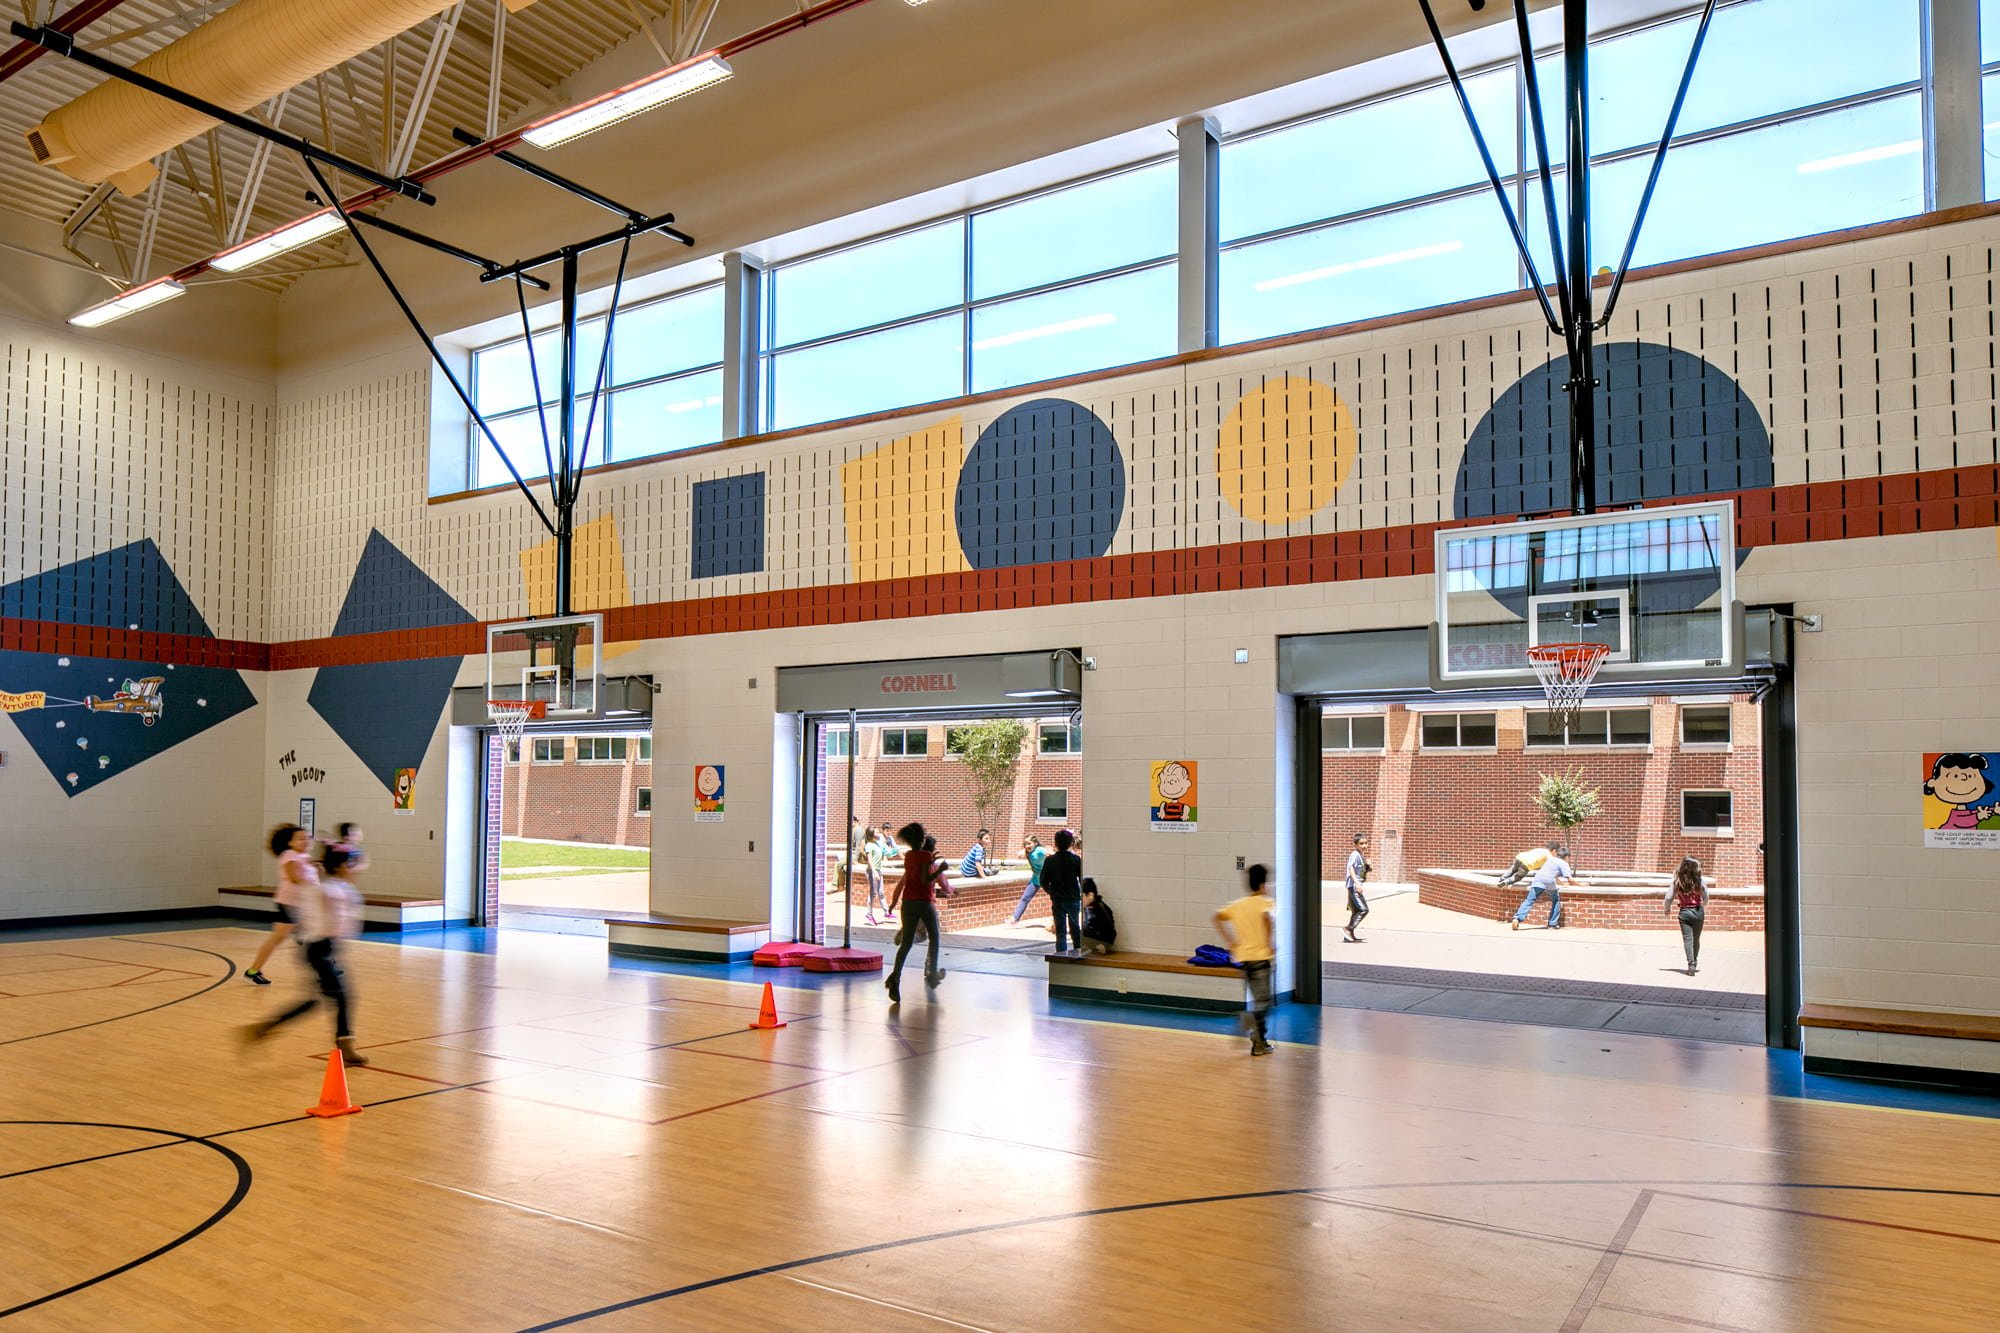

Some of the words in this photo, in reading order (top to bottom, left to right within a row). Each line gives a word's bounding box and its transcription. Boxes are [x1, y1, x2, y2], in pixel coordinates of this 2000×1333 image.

[881, 673, 957, 693] CORNELL
[279, 749, 296, 771] THE
[291, 766, 326, 787] DUGOUT
